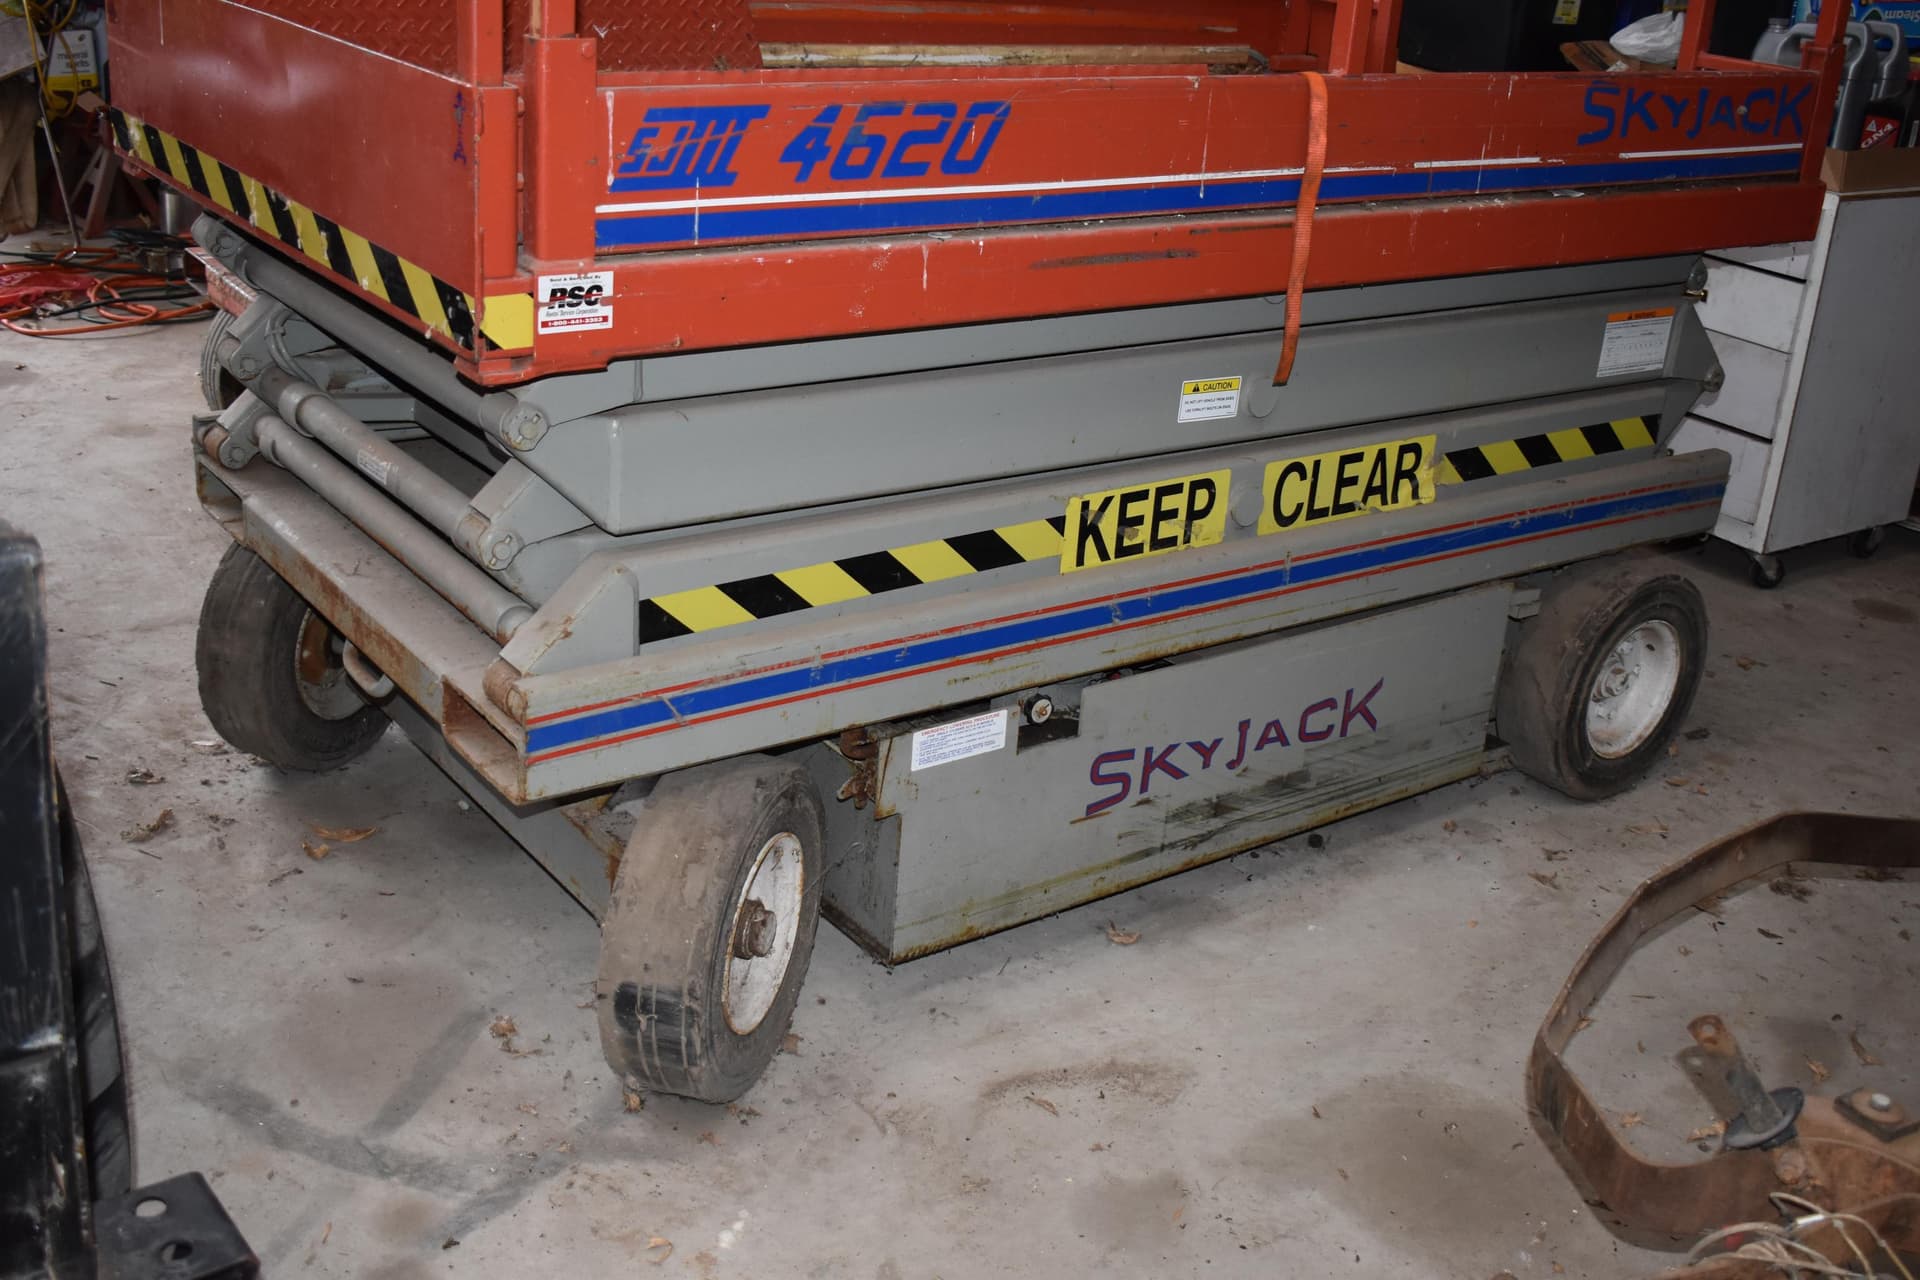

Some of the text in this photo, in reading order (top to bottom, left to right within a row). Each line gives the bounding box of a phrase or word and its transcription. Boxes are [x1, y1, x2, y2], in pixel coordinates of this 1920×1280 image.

[779, 100, 1012, 183] 4620
[1576, 80, 1814, 146] SKYJACK
[547, 284, 604, 309] RSC
[1202, 381, 1233, 392] CAUTION
[1076, 442, 1423, 567] KEEP CLEAR
[1086, 677, 1384, 816] SKYJACK
